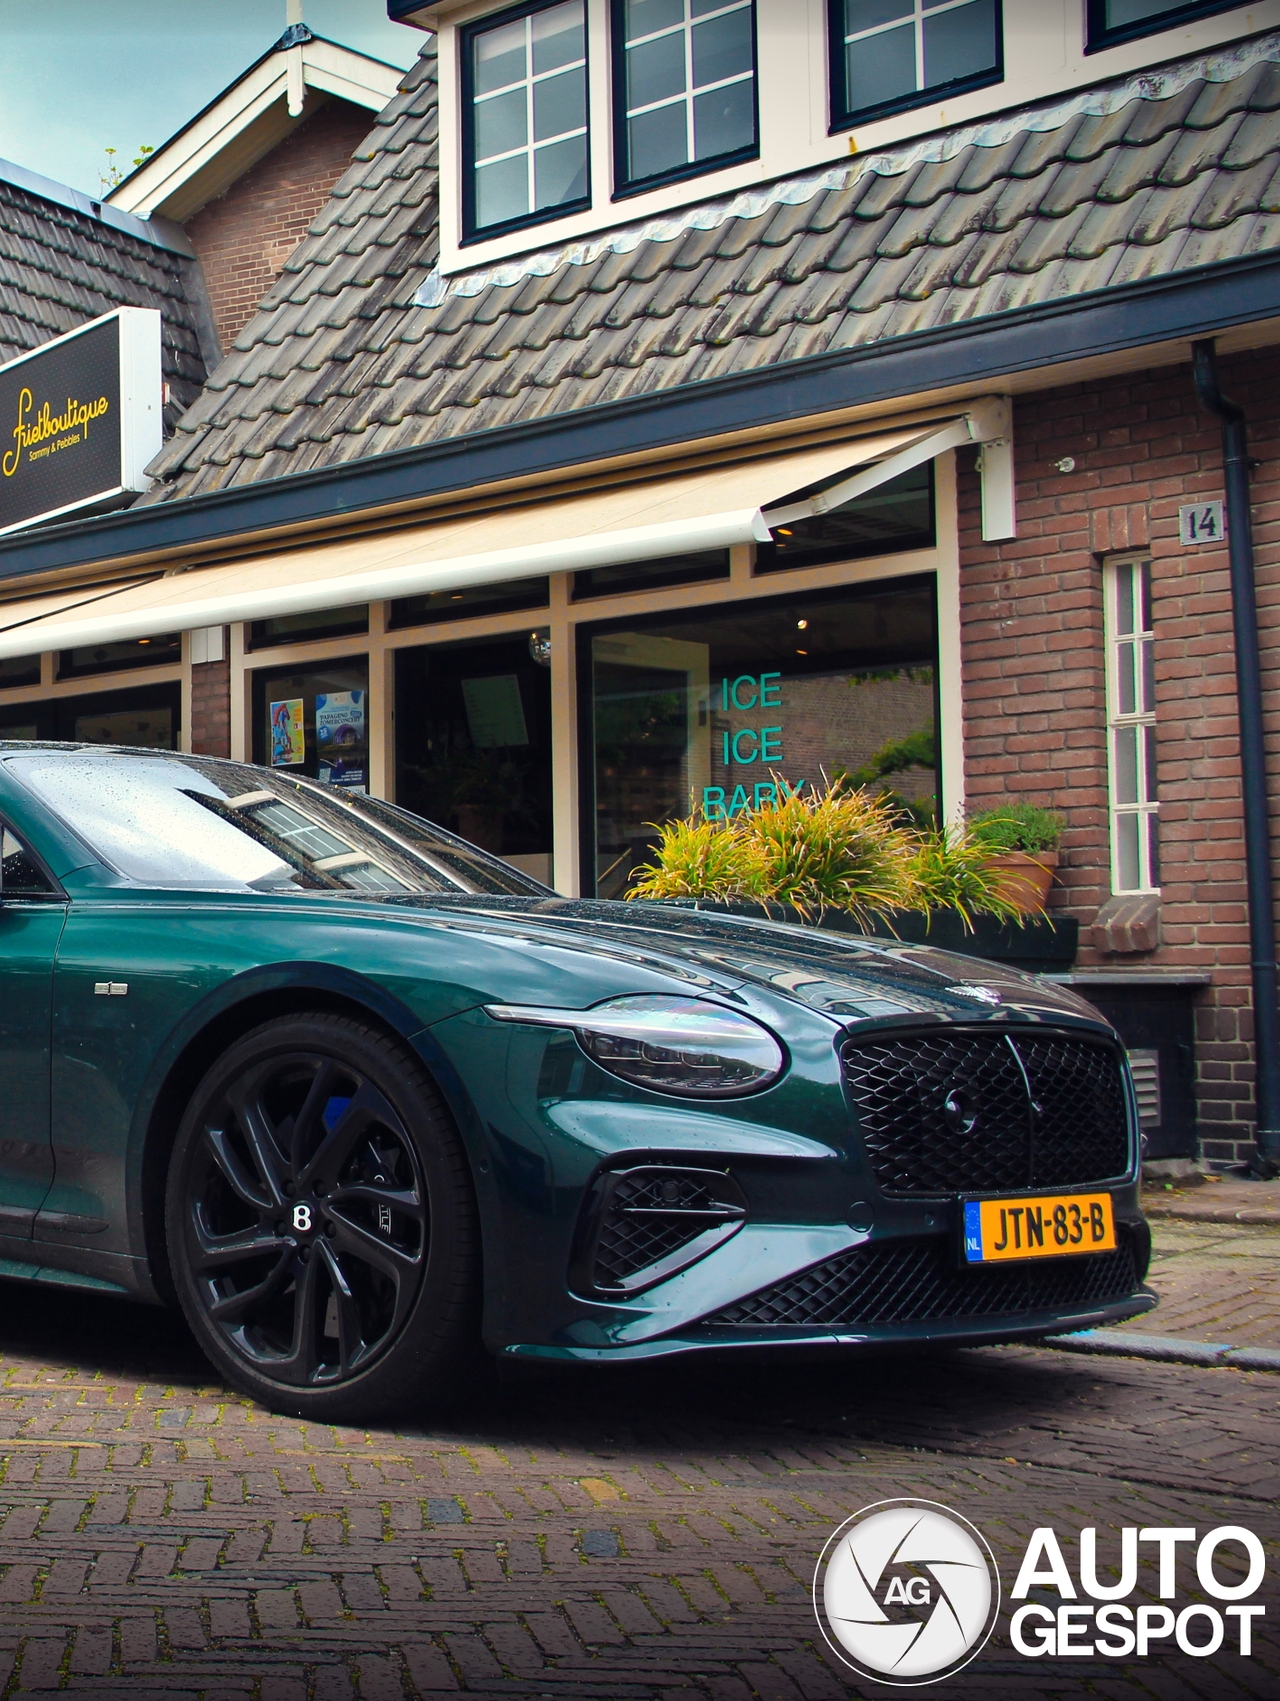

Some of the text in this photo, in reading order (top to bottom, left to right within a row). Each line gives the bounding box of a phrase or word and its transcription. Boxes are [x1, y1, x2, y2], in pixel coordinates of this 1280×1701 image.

[2, 388, 108, 476] Frietboutique
[30, 434, 80, 461] Sammy & Pebbles
[1189, 507, 1216, 539] 14
[722, 672, 782, 711] ICE
[723, 726, 783, 765] ICE
[293, 1205, 312, 1231] B
[994, 1202, 1105, 1251] JTN-83-B
[967, 1238, 980, 1250] NL
